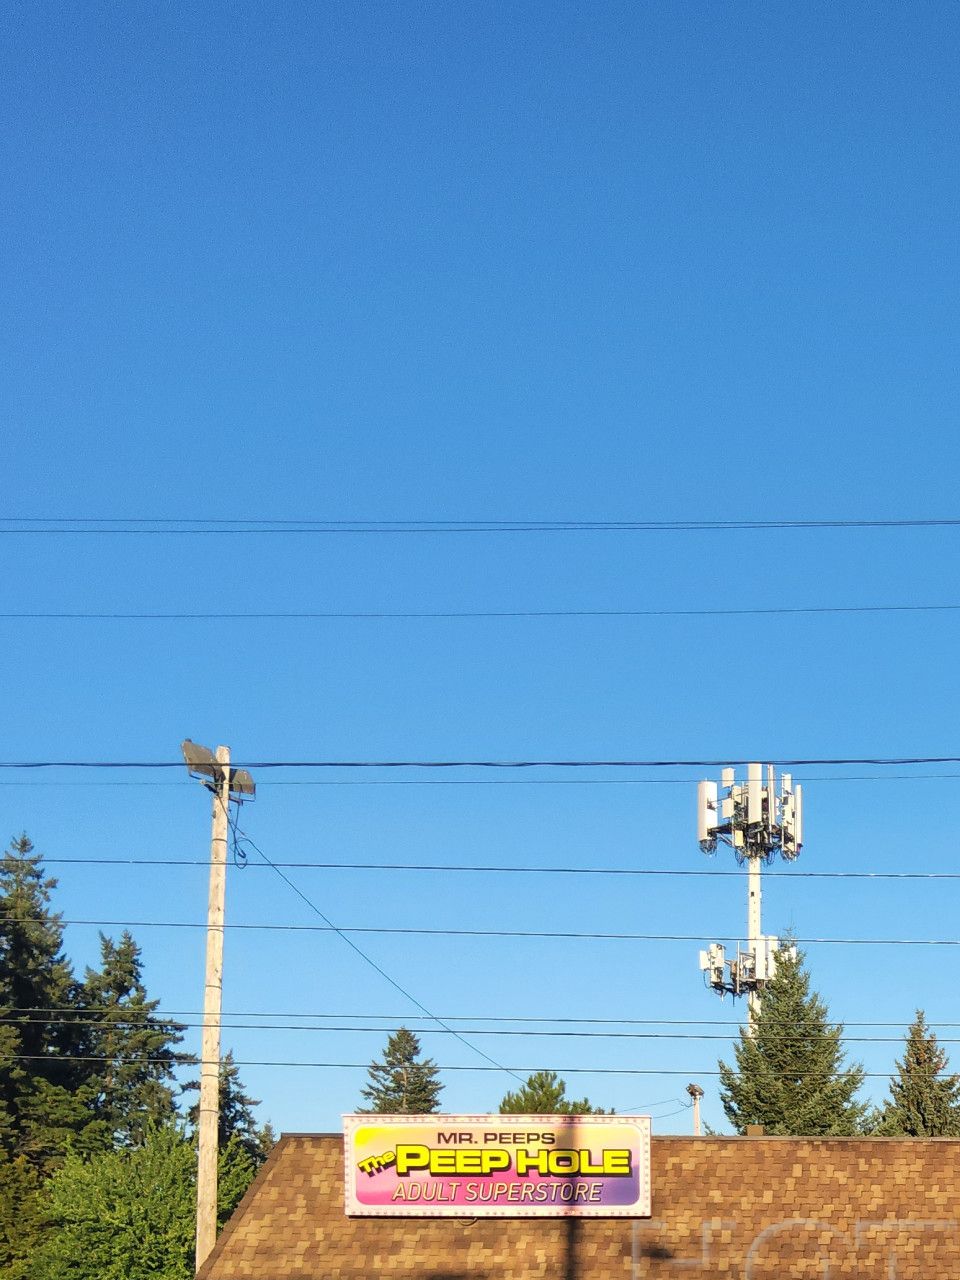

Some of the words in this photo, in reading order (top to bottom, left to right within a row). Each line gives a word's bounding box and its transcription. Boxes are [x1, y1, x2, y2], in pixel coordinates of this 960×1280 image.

[437, 1132, 478, 1144] MR.
[484, 1132, 555, 1144] PEEPS
[358, 1150, 396, 1176] The
[395, 1144, 509, 1176] PEEP
[517, 1149, 632, 1176] HOLE
[392, 1182, 461, 1201] ADULT
[465, 1182, 602, 1202] SUPERSTORE
